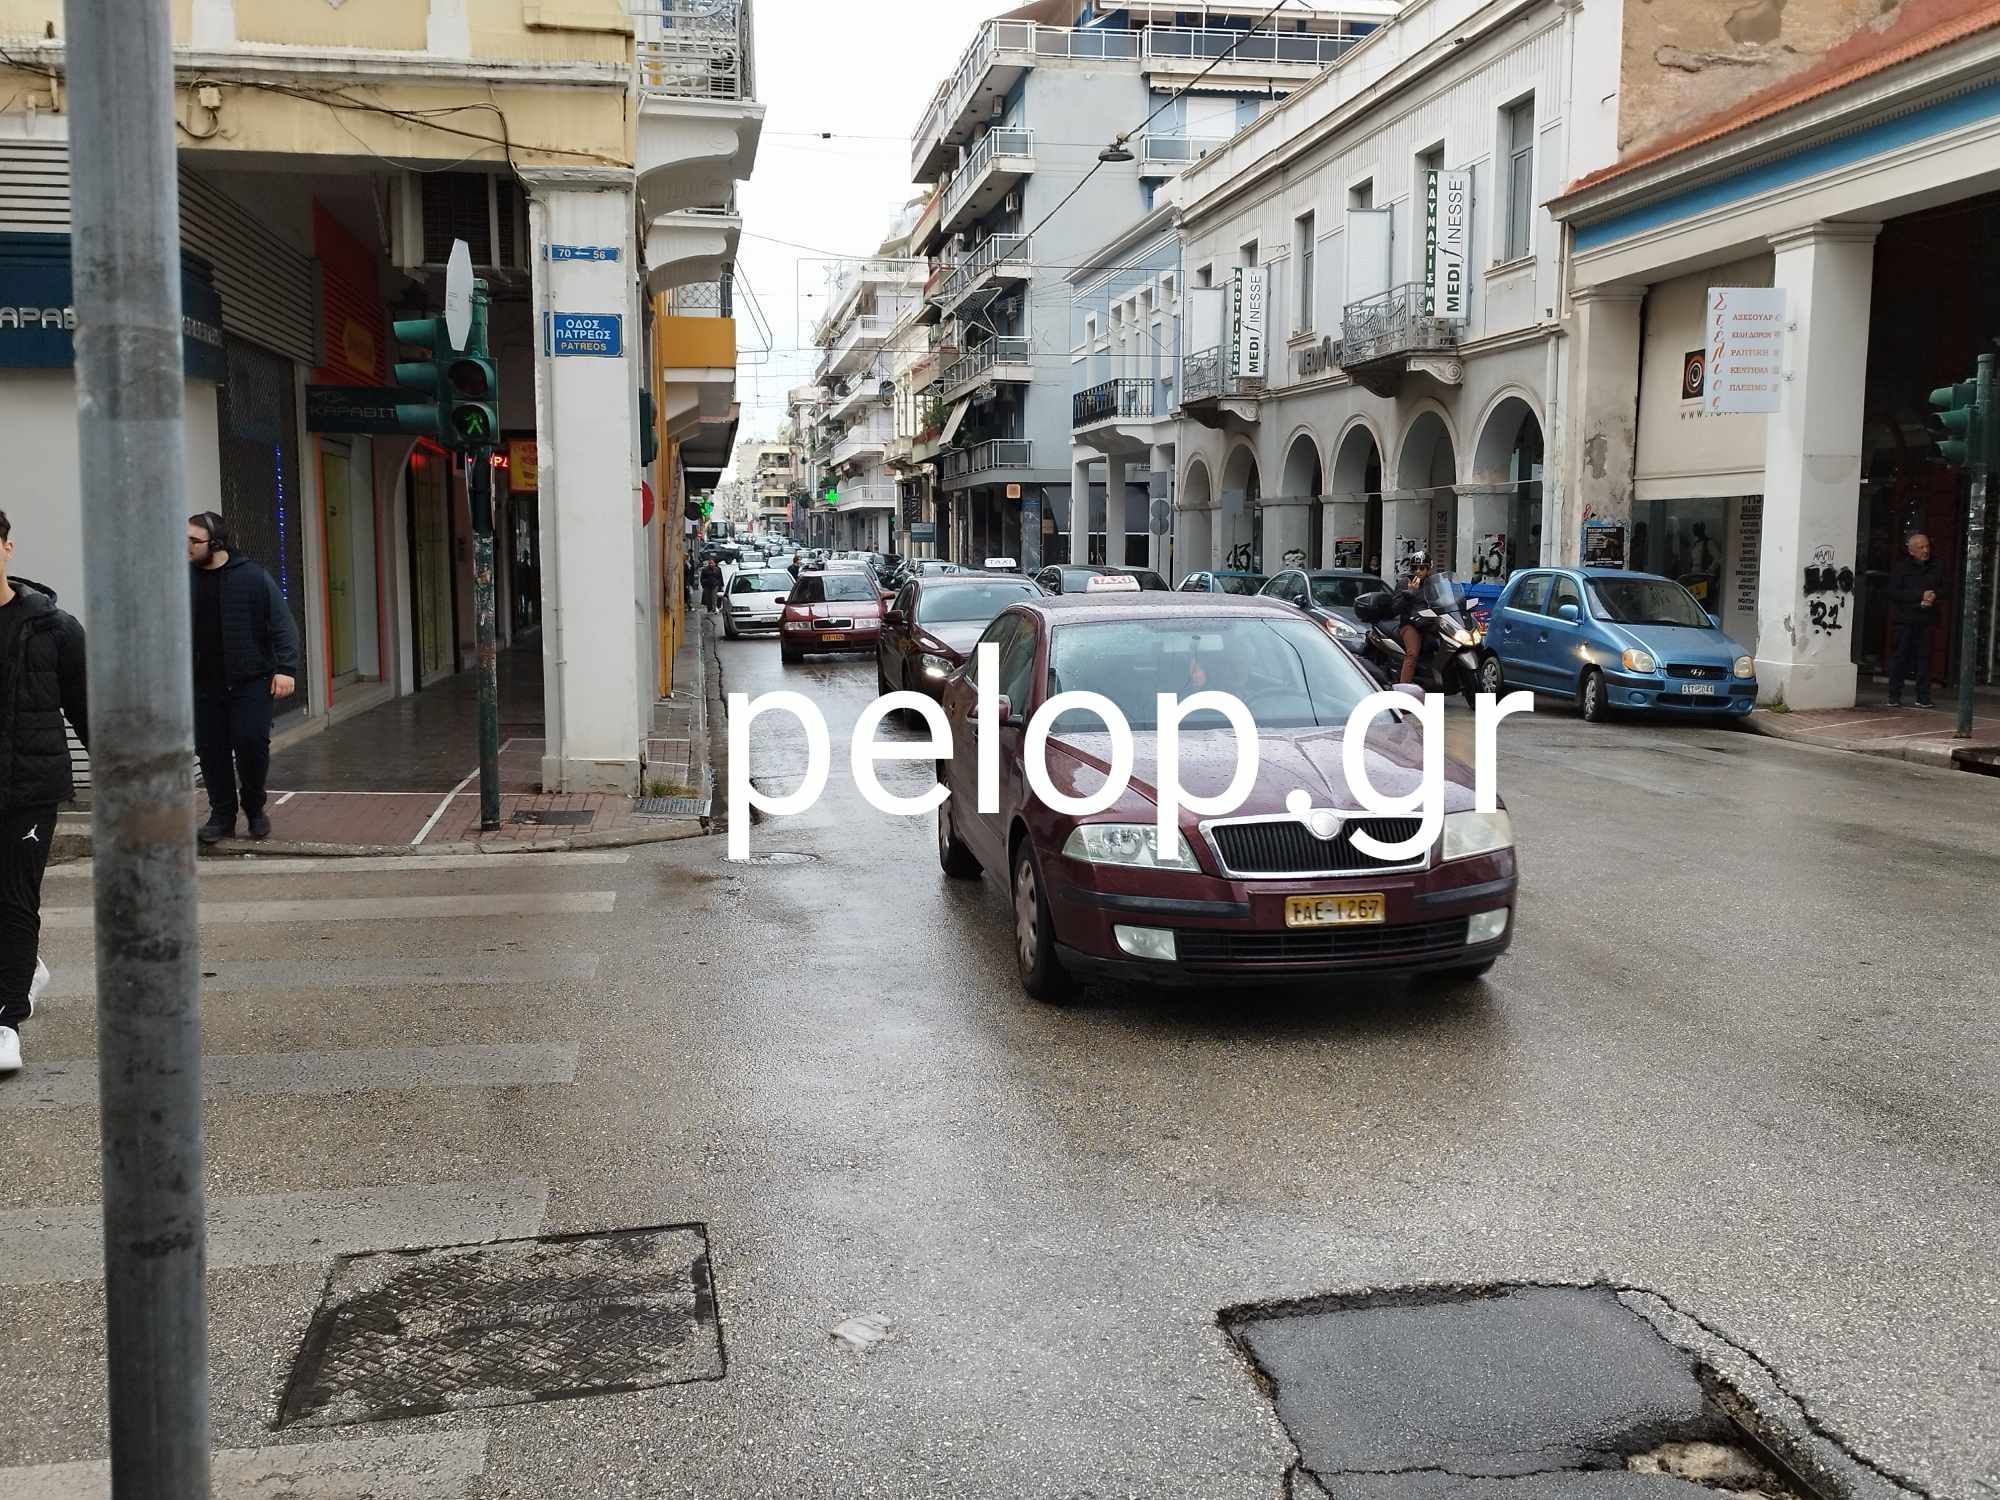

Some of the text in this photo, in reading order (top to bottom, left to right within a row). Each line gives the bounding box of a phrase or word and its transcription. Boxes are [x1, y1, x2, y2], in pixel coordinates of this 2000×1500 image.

[1425, 173, 1438, 313] ΑΔΥΝΑΤΙΣΜΑ
[559, 249, 606, 259] 70 56
[566, 319, 600, 329] ΟΔΟΣ
[1232, 270, 1242, 375] ΑΠΟΤΡΙΧΩΣΗ
[556, 329, 611, 340] ΠΑΤΡΕΩΣ
[560, 341, 607, 351] PATREOS
